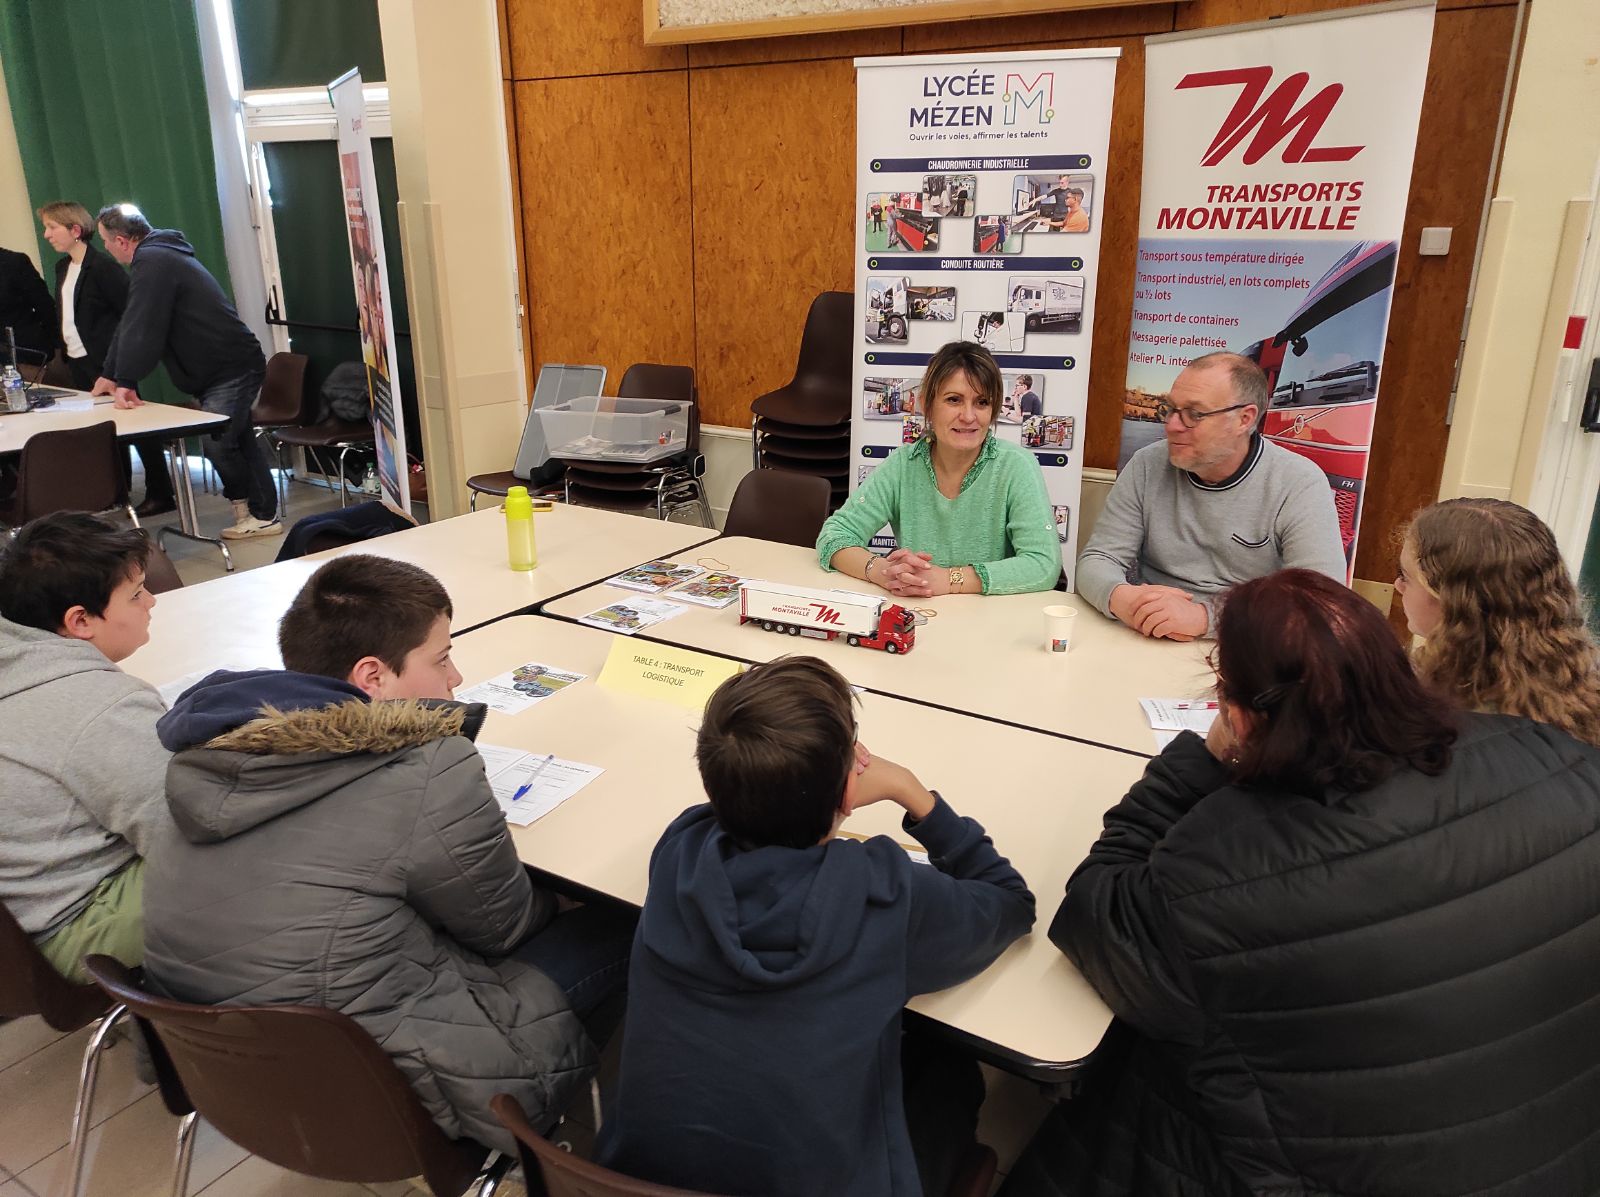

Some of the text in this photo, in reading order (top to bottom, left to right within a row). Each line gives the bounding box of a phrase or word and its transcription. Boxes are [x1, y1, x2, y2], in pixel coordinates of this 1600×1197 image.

[924, 69, 995, 97] LYCÉE
[909, 101, 993, 127] MÉZEN
[909, 130, 1048, 141] Ouvrir les voies, affirmer les talents
[928, 158, 1029, 170] CHAUDRONNERIE INDUSTRIELLE
[1207, 181, 1364, 203] TRANSPORTS
[1156, 206, 1361, 231] MONTAVILLE
[941, 258, 1004, 269] CONDUITE ROUTIÈRE
[1140, 250, 1305, 267] Transport sous température dirigée
[1137, 272, 1310, 291] Transport industriel, en lots complets
[1135, 291, 1144, 299] ou
[1154, 289, 1172, 301] lots
[1133, 310, 1239, 327] Transport de containers
[1131, 331, 1227, 348] Messagerie palettisée
[1129, 352, 1154, 364] Atelier
[1156, 354, 1167, 365] PL
[1341, 480, 1355, 488] FH
[771, 606, 810, 617] MONTAVILLE
[632, 655, 653, 667] TABLE
[663, 661, 705, 677] TRANSPORT
[642, 671, 685, 687] LOGISTIQUE
